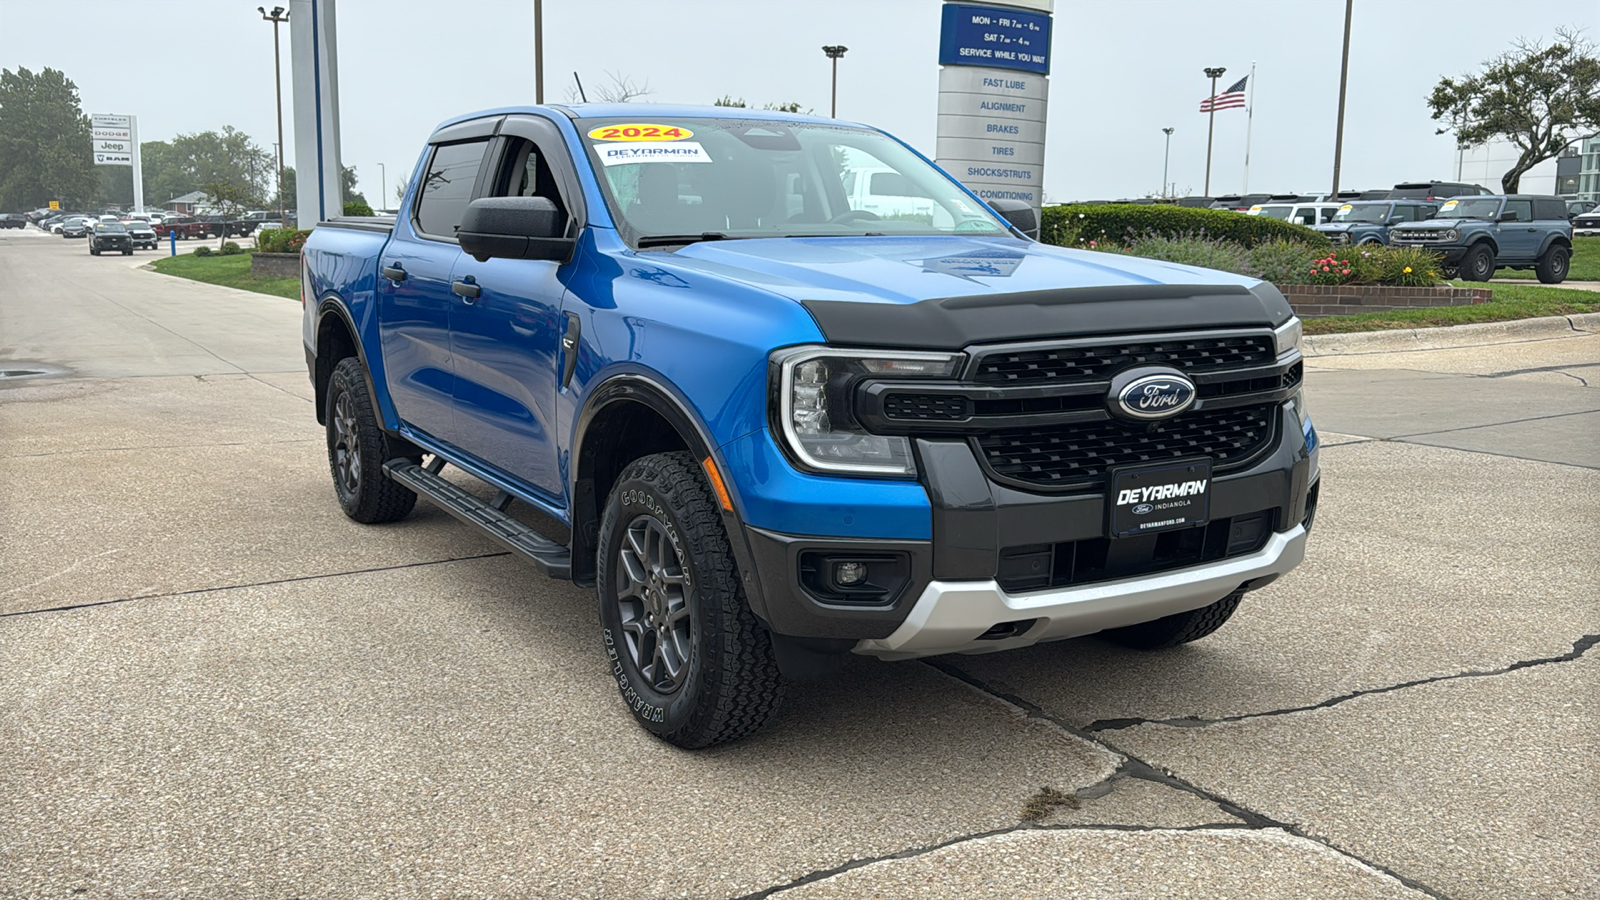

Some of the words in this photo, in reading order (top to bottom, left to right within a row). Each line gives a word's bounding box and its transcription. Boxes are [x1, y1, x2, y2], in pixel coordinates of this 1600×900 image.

[972, 16, 990, 25] MON
[999, 18, 1010, 27] FRI
[984, 33, 998, 42] SAT
[959, 47, 992, 57] SERVICE
[994, 50, 1016, 60] WHILE
[1017, 53, 1031, 62] YOU
[1032, 55, 1046, 64] WAIT
[983, 78, 1004, 87] FAST
[1005, 80, 1026, 89] LUBE
[980, 101, 1026, 112] ALIGNMENT
[602, 127, 683, 139] 2024
[986, 124, 1019, 134] BRAKES
[101, 141, 124, 151] Jeep
[992, 146, 1014, 156] TIRES
[607, 148, 698, 157] DEYARMAN
[967, 167, 1032, 179] SHOCKS/STRUTS
[980, 189, 1033, 201] CONDITIONING
[1140, 384, 1180, 408] Ford
[1116, 479, 1207, 506] DEYARMAN
[1155, 499, 1192, 510] INDIANOLA
[1140, 517, 1185, 529] DEYARMANFORD.COM
[622, 489, 691, 586] GOODYEAR
[603, 628, 664, 723] WRANGLER
